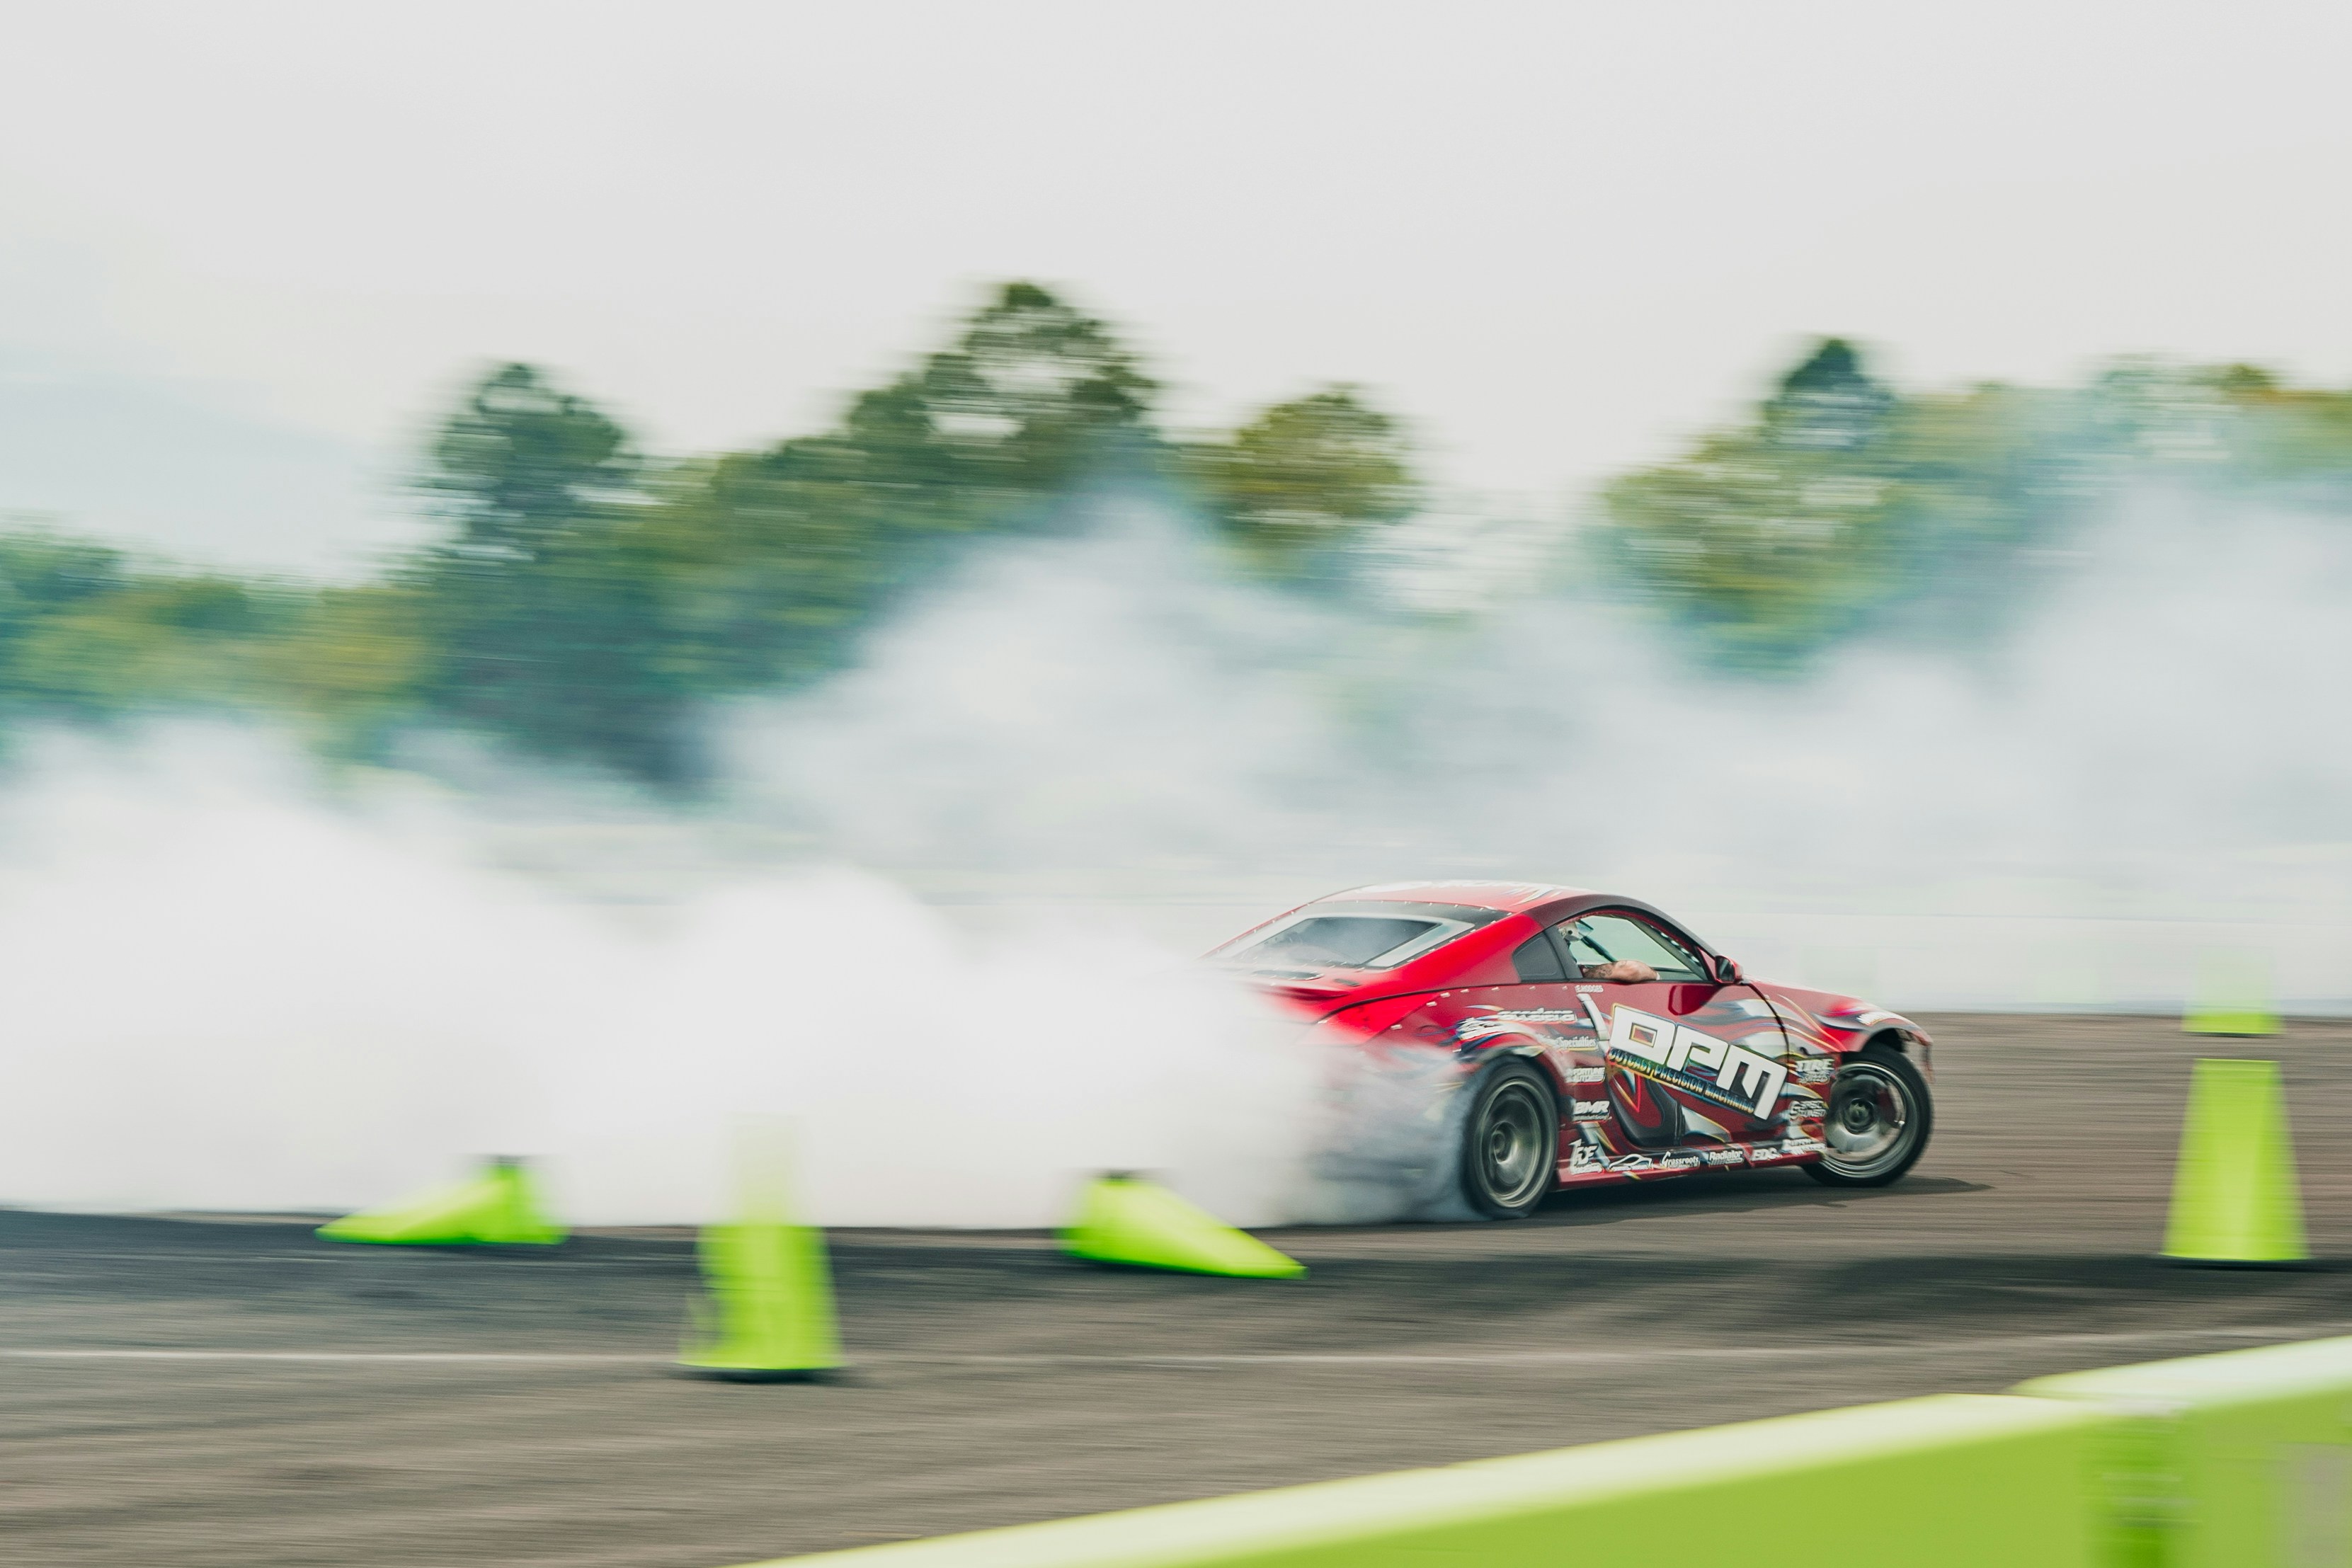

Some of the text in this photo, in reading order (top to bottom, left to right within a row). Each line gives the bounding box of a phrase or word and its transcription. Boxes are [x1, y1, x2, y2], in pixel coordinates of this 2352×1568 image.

[1609, 1005, 1788, 1120] OPM
[1654, 1065, 1703, 1092] PRECISION
[1705, 1085, 1754, 1114] MACHINING
[1573, 1101, 1609, 1114] BMR
[1660, 1151, 1699, 1168] Grassroots
[1709, 1150, 1742, 1161] Radiator
